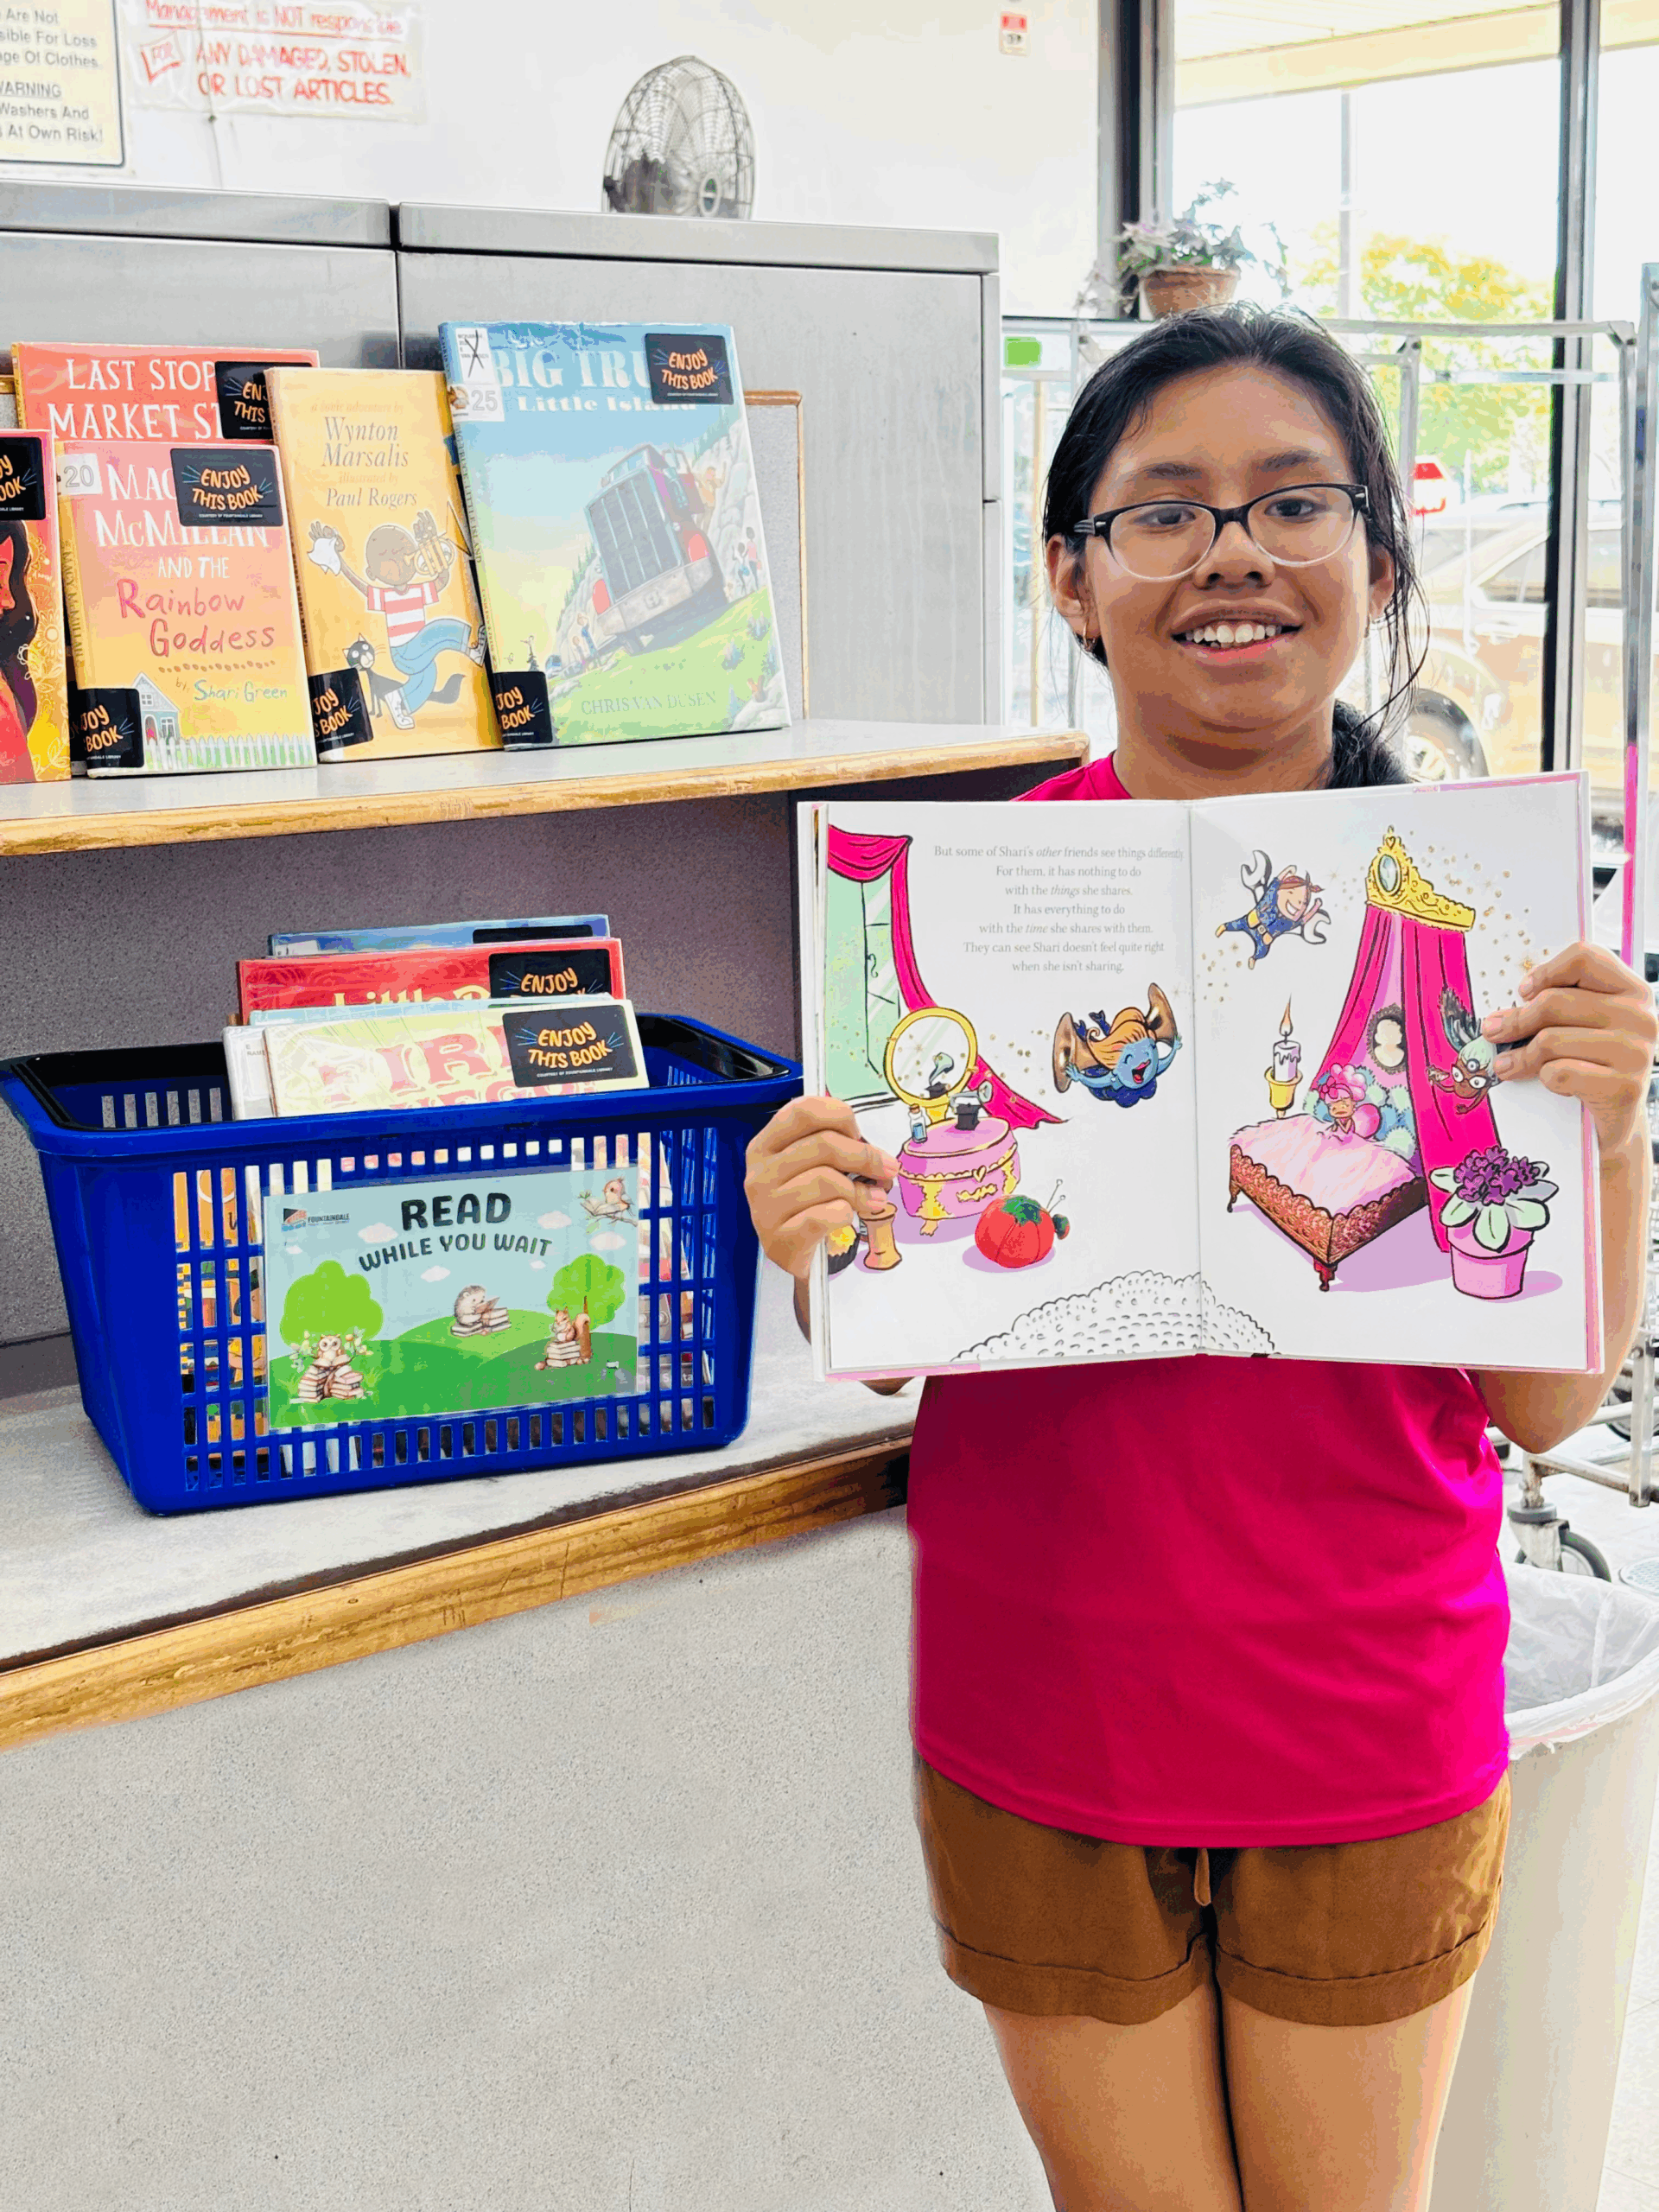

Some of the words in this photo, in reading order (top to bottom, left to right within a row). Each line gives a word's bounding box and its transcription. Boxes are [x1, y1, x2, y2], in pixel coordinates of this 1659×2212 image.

[6, 8, 29, 22] Are
[35, 10, 59, 24] Not
[36, 30, 59, 44] For
[63, 33, 98, 48] Loss
[24, 50, 41, 64] Of
[44, 52, 99, 68] Clothes
[196, 41, 231, 65] ANY
[198, 72, 226, 96] OR
[235, 74, 283, 99] LOST
[62, 105, 90, 120] And
[8, 124, 22, 138] At
[29, 124, 61, 141] Own
[67, 126, 103, 143] Risk!
[492, 349, 563, 389] BIG
[668, 348, 708, 372] ENJOY
[67, 359, 136, 391] LAST
[149, 359, 216, 391] STOP
[661, 369, 690, 390] THIS
[690, 366, 718, 390] BOOK
[234, 400, 265, 423] THIS
[471, 390, 499, 411] 25
[518, 396, 599, 412] Little
[48, 403, 180, 440] MARKET
[322, 416, 397, 448] Wynton
[321, 442, 409, 467] Marsalis
[64, 464, 94, 488] 20
[200, 464, 251, 489] ENJOY
[338, 471, 387, 484] illustrated
[389, 472, 398, 486] by
[193, 487, 226, 511] THIS
[227, 484, 264, 511] BOOK
[327, 487, 362, 506] Paul
[368, 487, 417, 510] Rogers
[158, 556, 192, 578] AND
[198, 556, 230, 578] THE
[117, 579, 245, 619] Rainbow
[149, 618, 276, 658] Goddess
[194, 679, 238, 702] Shari
[244, 680, 288, 703] Green
[581, 696, 631, 716] CHRIS
[630, 695, 664, 711] VAN
[667, 690, 716, 709] DUSEN
[320, 704, 353, 734] BOOK
[500, 704, 535, 729] BOOK
[86, 724, 124, 753] BOOK
[934, 846, 952, 856] But
[986, 846, 997, 856] of
[1036, 847, 1062, 857] other
[1064, 847, 1098, 857] friends
[1118, 847, 1146, 861] things
[996, 866, 1014, 876] For
[1048, 866, 1055, 876] it
[1058, 866, 1075, 876] has
[1078, 867, 1116, 879] nothing
[1118, 868, 1128, 877] to
[1129, 868, 1141, 877] do
[1005, 886, 1028, 895] with
[1032, 886, 1047, 895] the
[1051, 886, 1079, 898] things
[1083, 886, 1098, 895] she
[1014, 905, 1020, 914] It
[1024, 905, 1041, 914] has
[1045, 905, 1098, 917] everything
[1113, 905, 1124, 914] do
[979, 924, 1003, 933] with
[1007, 923, 1023, 933] the
[1026, 923, 1047, 933] time
[1051, 924, 1067, 933] she
[1070, 924, 1101, 933] shares
[1104, 924, 1125, 933] with
[963, 942, 989, 954] They
[1033, 942, 1059, 952] Shari
[1100, 941, 1116, 952] feel
[1119, 942, 1141, 954] quite
[1144, 942, 1165, 954] right
[1013, 961, 1039, 971] when
[1043, 961, 1060, 971] she
[520, 967, 578, 994] ENJOY
[537, 1021, 596, 1048] ENJOY
[528, 1048, 569, 1069] THIS
[569, 1039, 613, 1069] BOOK
[308, 1213, 350, 1223] FOUNTAINDALE
[401, 1192, 512, 1231] READ
[359, 1237, 433, 1272] WHILE
[439, 1233, 486, 1252] YOU
[493, 1233, 552, 1256] WAIT
